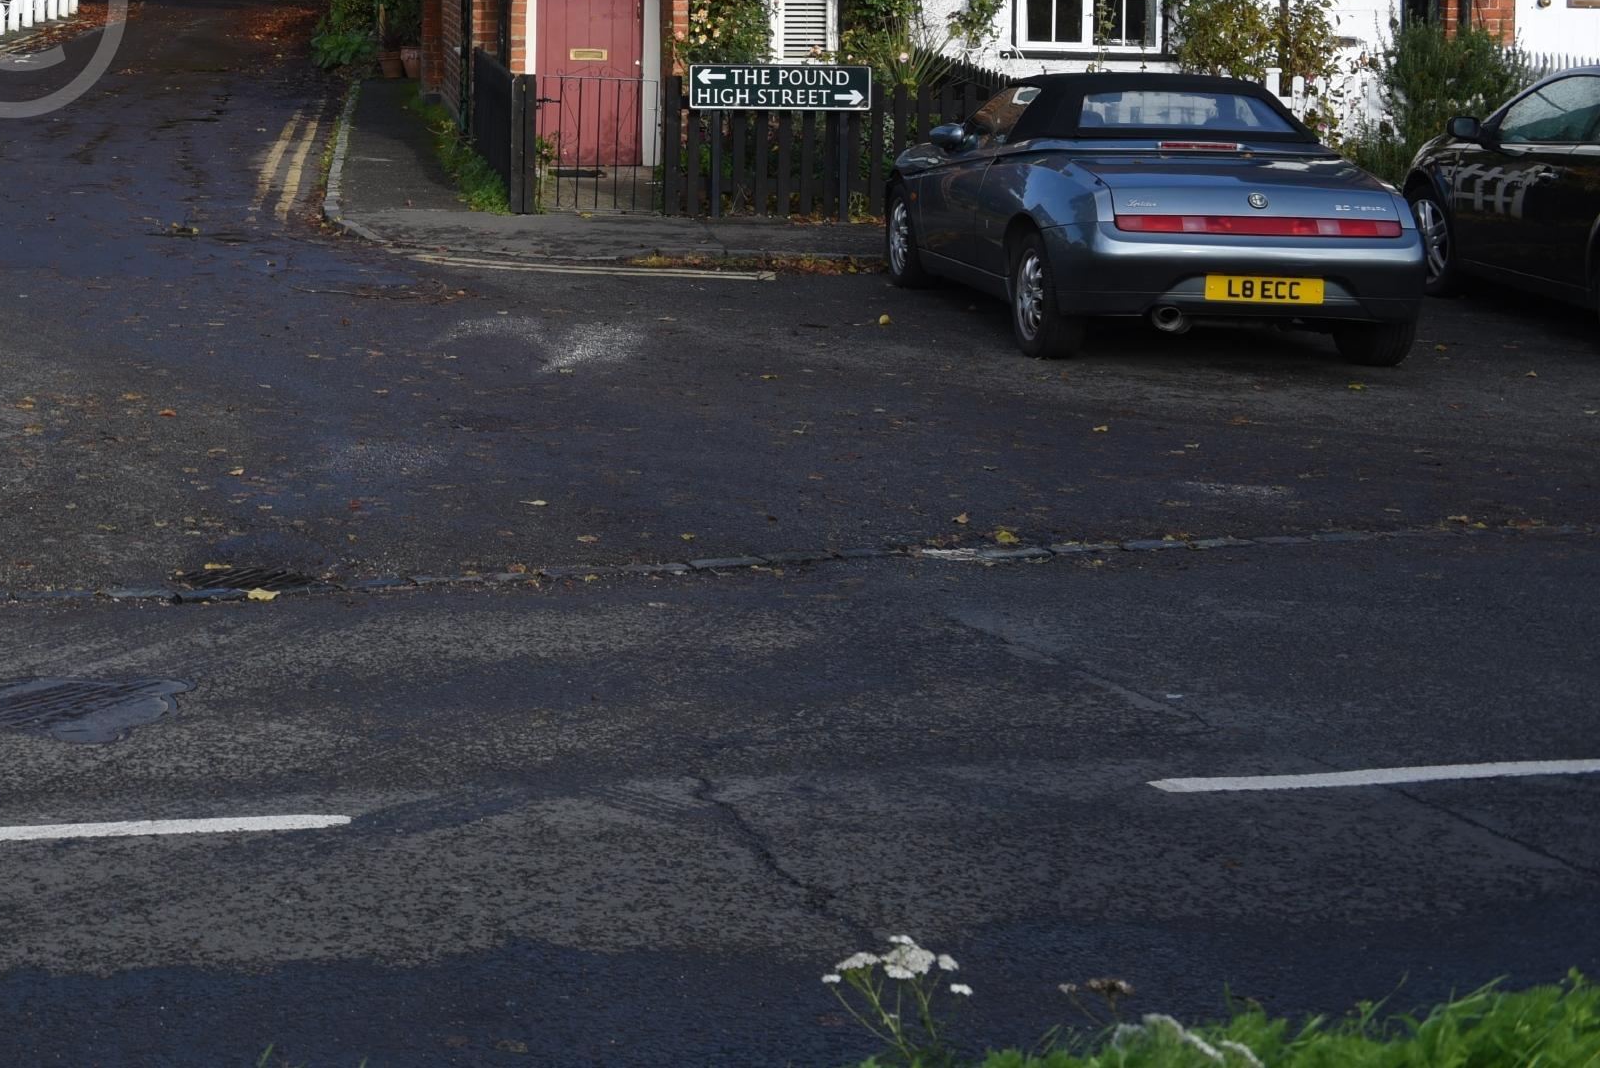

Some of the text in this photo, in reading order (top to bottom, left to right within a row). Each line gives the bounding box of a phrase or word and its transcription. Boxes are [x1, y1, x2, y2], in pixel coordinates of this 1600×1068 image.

[730, 69, 850, 86] THE POUND
[697, 88, 831, 105] HIGH STREET
[1227, 279, 1301, 301] L8 ECC
